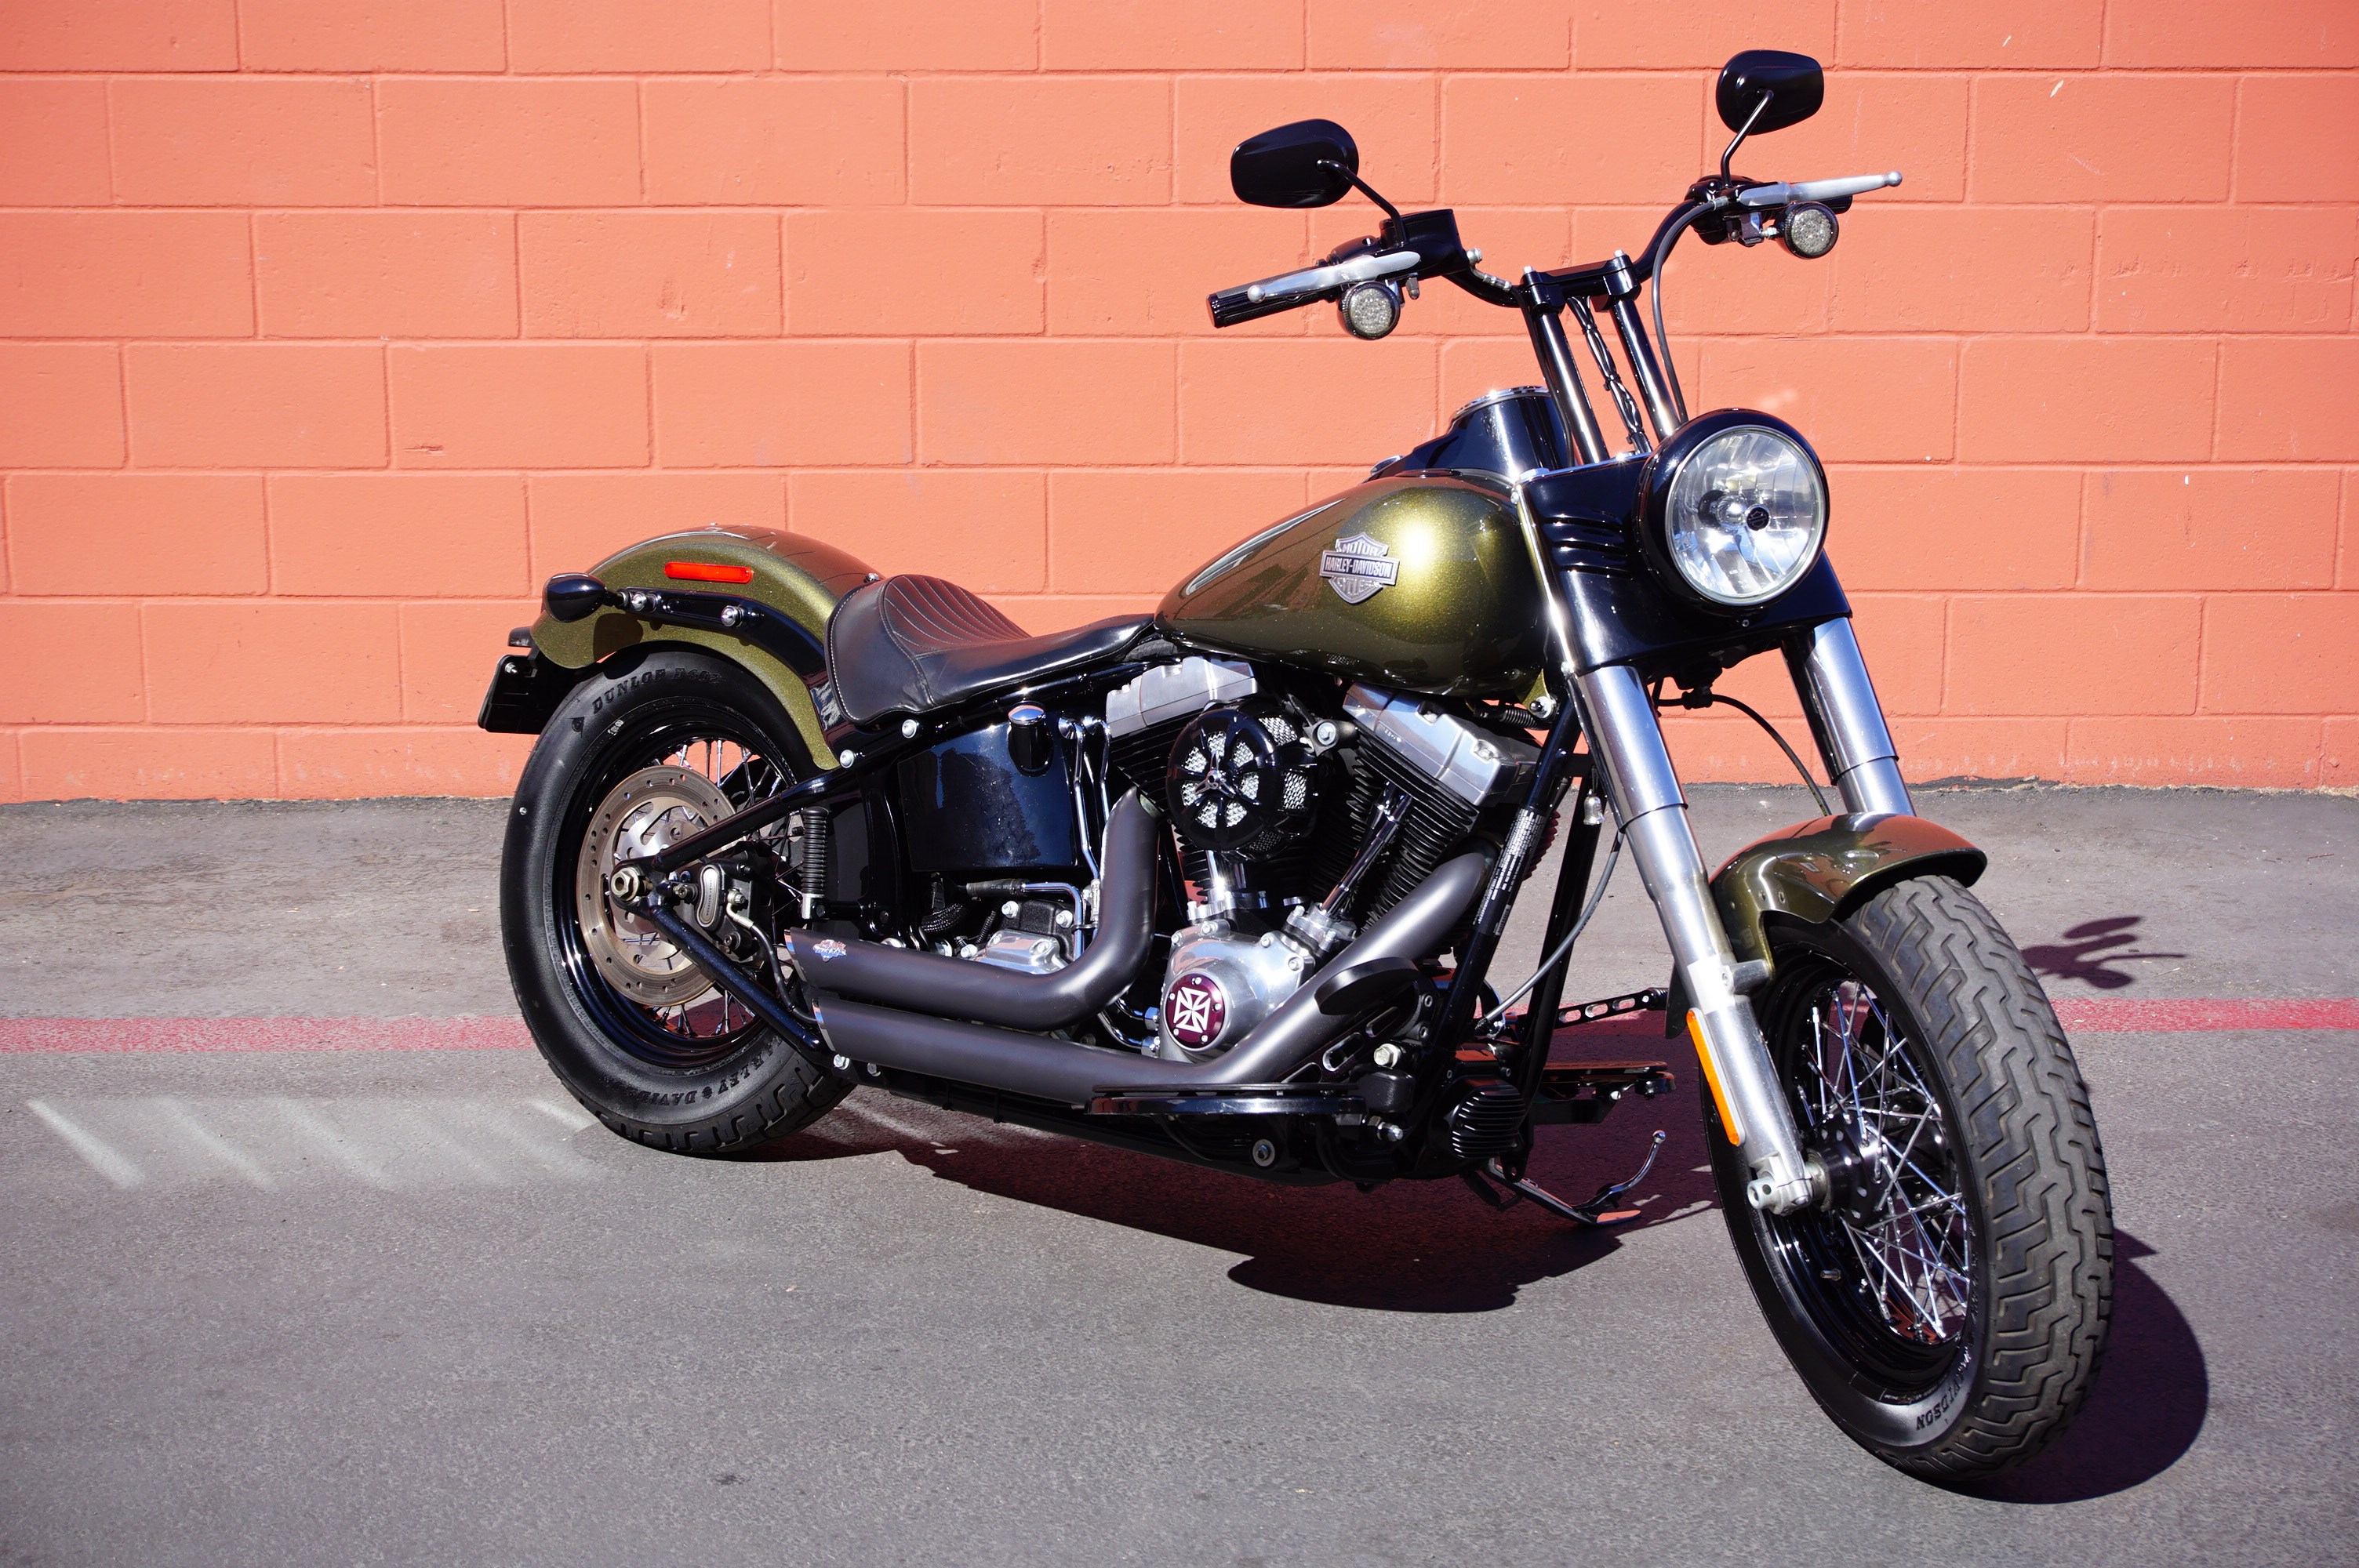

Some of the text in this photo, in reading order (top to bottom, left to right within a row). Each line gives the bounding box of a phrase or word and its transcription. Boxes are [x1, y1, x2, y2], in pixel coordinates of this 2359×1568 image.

[1342, 541, 1380, 556] MOTOR
[1324, 556, 1393, 578] HARLEY-DAVIDSON
[592, 667, 722, 714] DUNLOP D402
[599, 1073, 697, 1106] DAVIDSON
